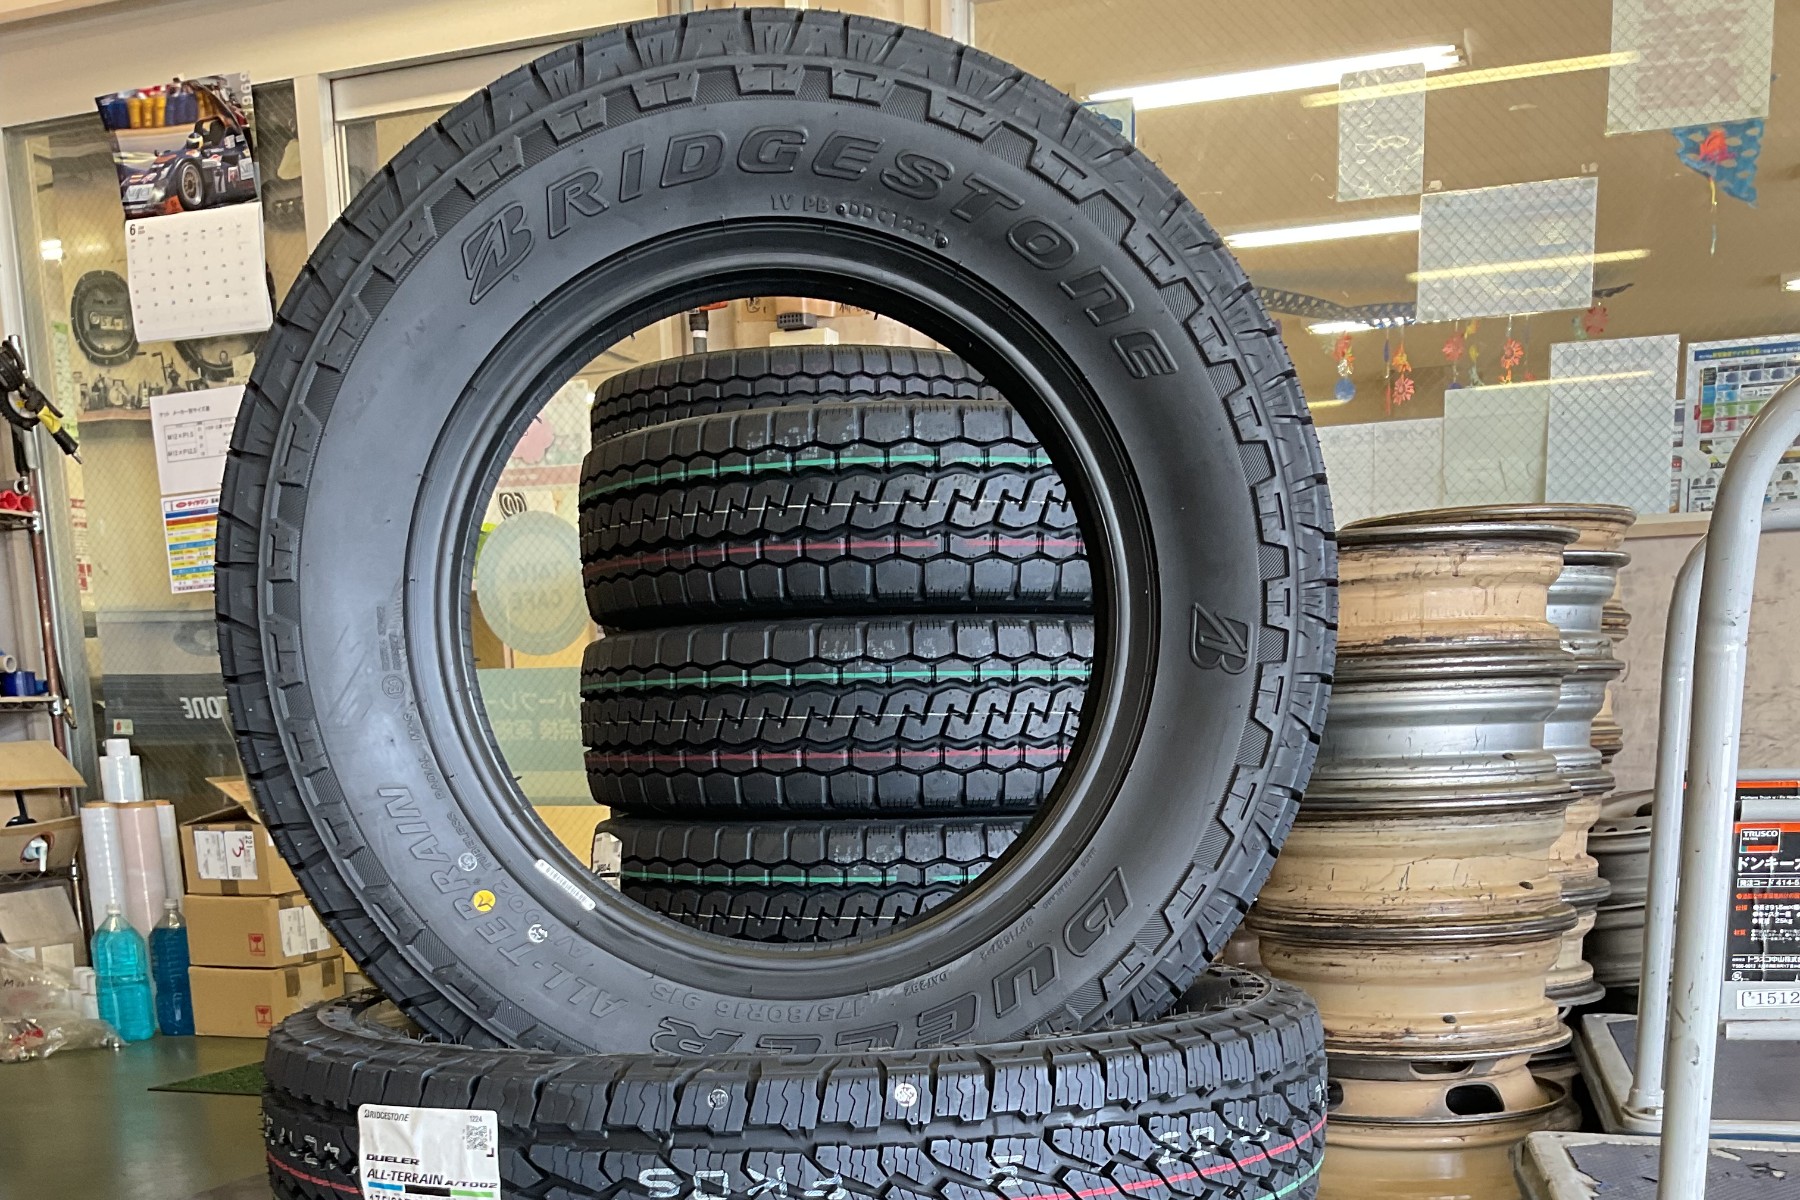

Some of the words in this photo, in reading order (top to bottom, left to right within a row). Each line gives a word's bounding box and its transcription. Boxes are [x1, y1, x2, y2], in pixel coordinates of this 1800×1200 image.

[129, 224, 136, 236] 6
[463, 125, 1178, 378] BRIDGESTONE
[418, 752, 446, 800] RADIAL
[447, 809, 492, 871] TUBELESS
[1742, 830, 1779, 838] TRUSCO
[378, 784, 629, 1019] ALL-TERRAIN
[715, 998, 865, 1026] 175/80R16
[364, 1109, 410, 1122] BRIDGESTONE
[470, 1115, 483, 1123] 1224
[366, 1153, 420, 1166] DUELER
[366, 1168, 444, 1186] ALL-TERRAIN
[444, 1180, 498, 1189] A/T002
